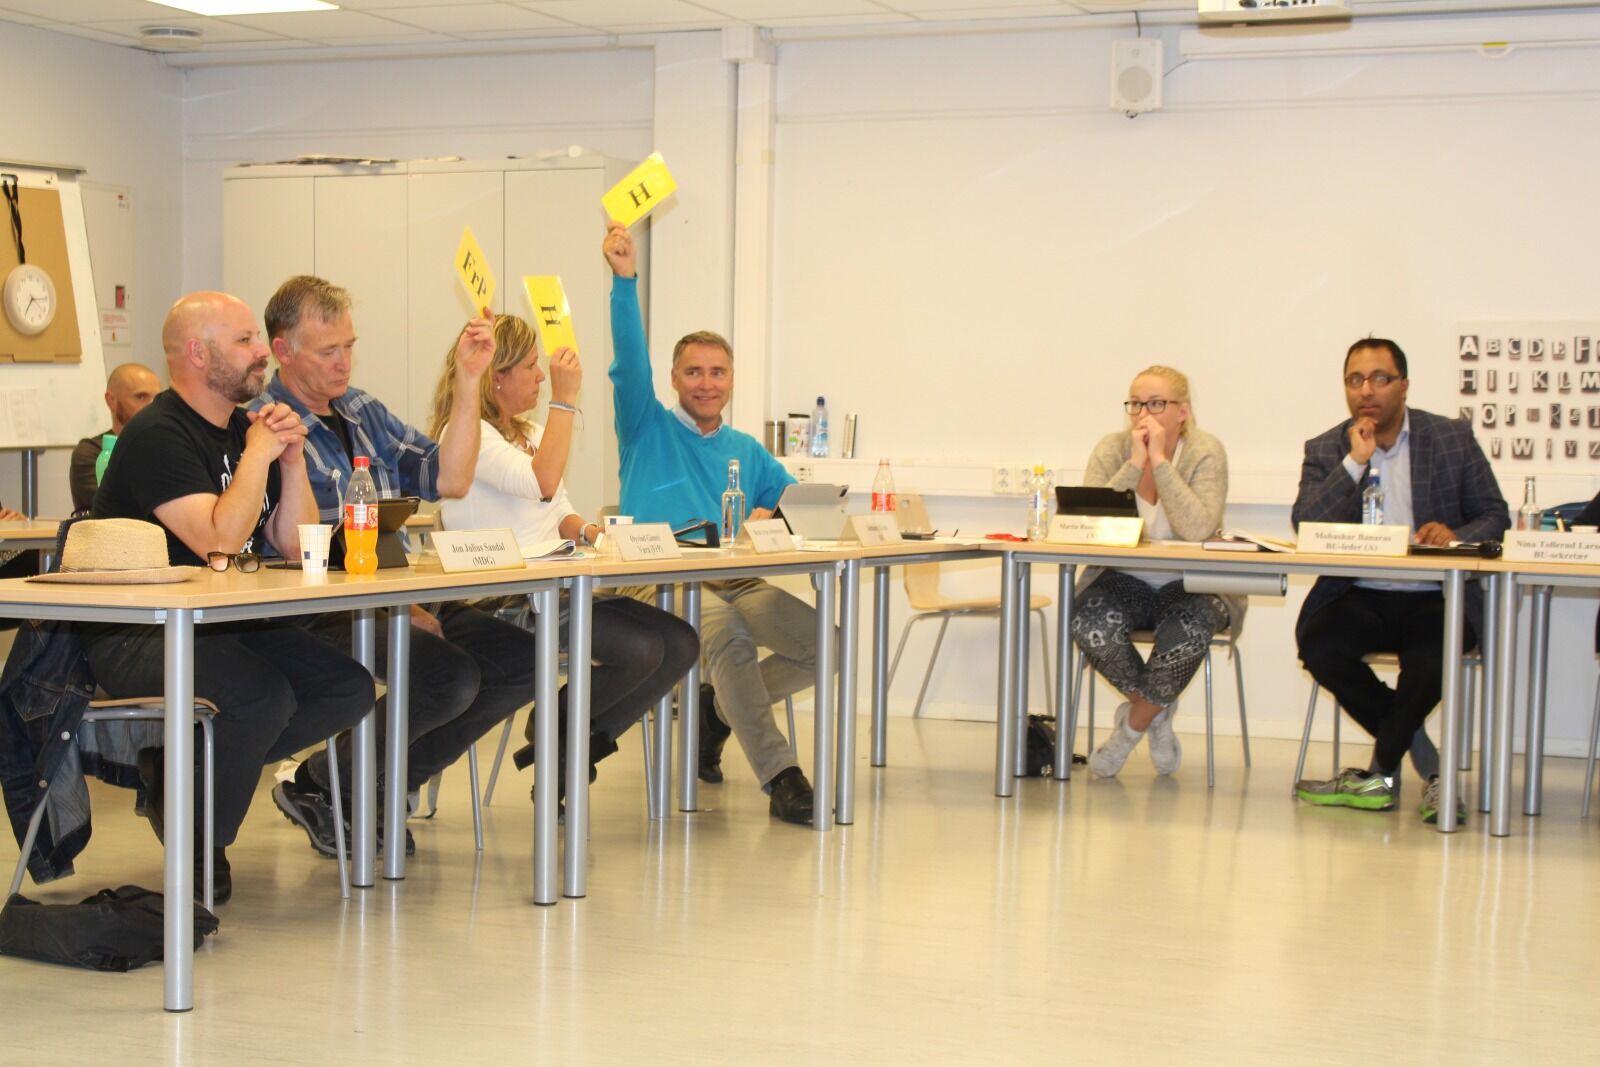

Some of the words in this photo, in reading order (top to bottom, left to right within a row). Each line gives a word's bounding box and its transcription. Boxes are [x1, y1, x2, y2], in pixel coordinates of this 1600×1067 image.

[628, 182, 652, 208] H
[462, 250, 487, 296] FrP
[541, 304, 561, 327] H
[1460, 336, 1478, 356] A
[1529, 340, 1543, 357] D
[1575, 337, 1589, 361] F
[1460, 370, 1477, 391] H
[1532, 371, 1548, 388] K
[1482, 404, 1496, 424] O
[1512, 439, 1533, 456] W
[451, 543, 464, 553] Jon
[464, 542, 484, 553] Julius
[484, 541, 506, 551] Sandal
[472, 556, 496, 567] (MDG)
